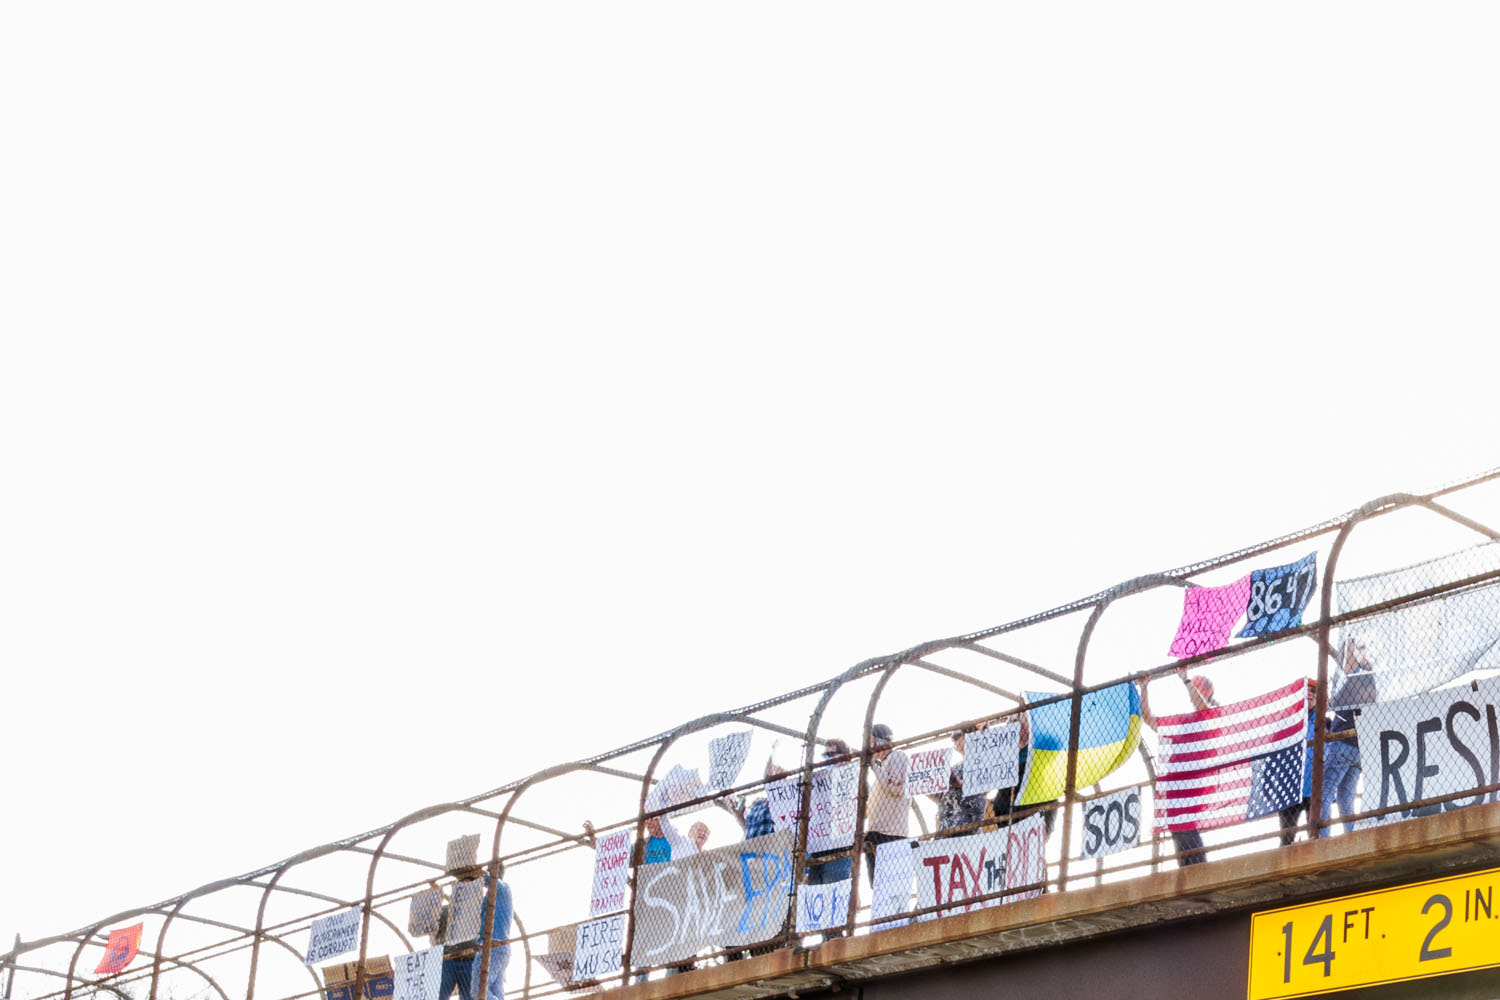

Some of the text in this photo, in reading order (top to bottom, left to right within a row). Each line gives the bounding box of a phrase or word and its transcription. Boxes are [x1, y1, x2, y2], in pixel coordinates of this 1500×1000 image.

[910, 749, 948, 771] THINK
[1085, 793, 1141, 856] SOS
[596, 851, 628, 873] TRUMP
[922, 847, 987, 918] TAX
[591, 892, 625, 911] TRAITOR
[643, 861, 737, 956] SAVE
[737, 848, 796, 934] EPA
[581, 918, 621, 949] FIRE
[1419, 893, 1453, 962] 2
[407, 952, 428, 973] EAT
[575, 949, 622, 976] MUSK
